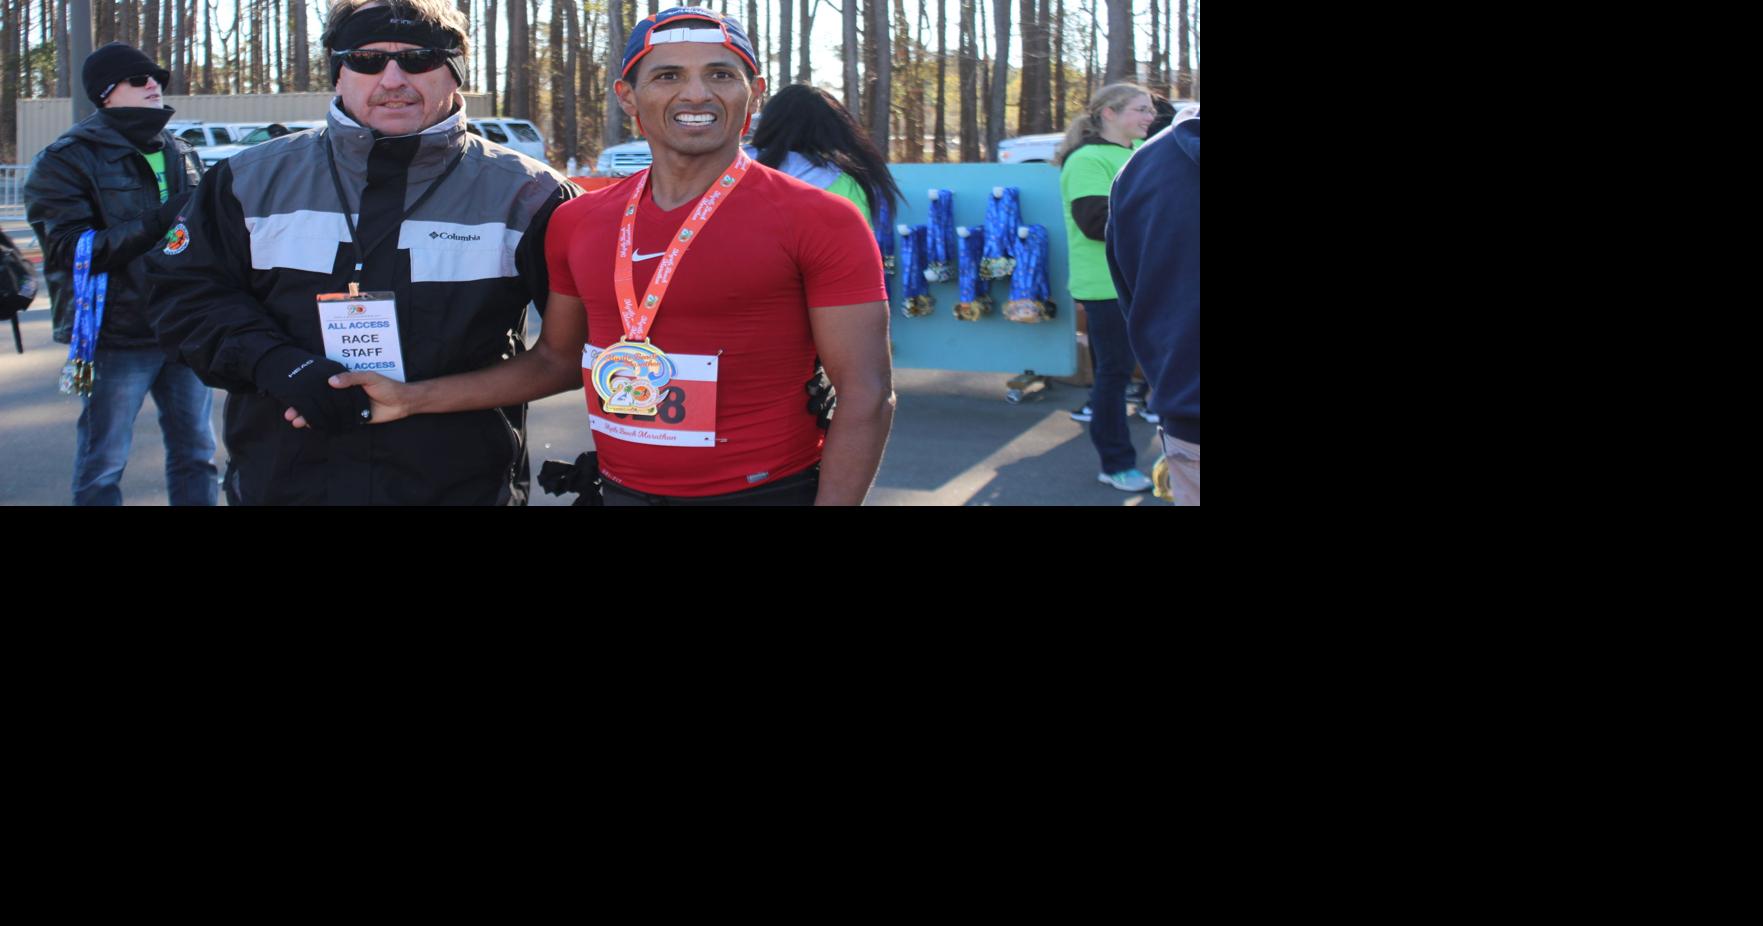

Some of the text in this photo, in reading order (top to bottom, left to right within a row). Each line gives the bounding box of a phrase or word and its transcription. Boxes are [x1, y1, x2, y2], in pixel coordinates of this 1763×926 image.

[440, 232, 480, 241] Columbia
[328, 321, 390, 330] ALL ACCESS
[341, 334, 379, 343] RACE
[341, 347, 383, 357] STAFF
[354, 361, 396, 370] ACCESS
[638, 431, 677, 441] Marathon
